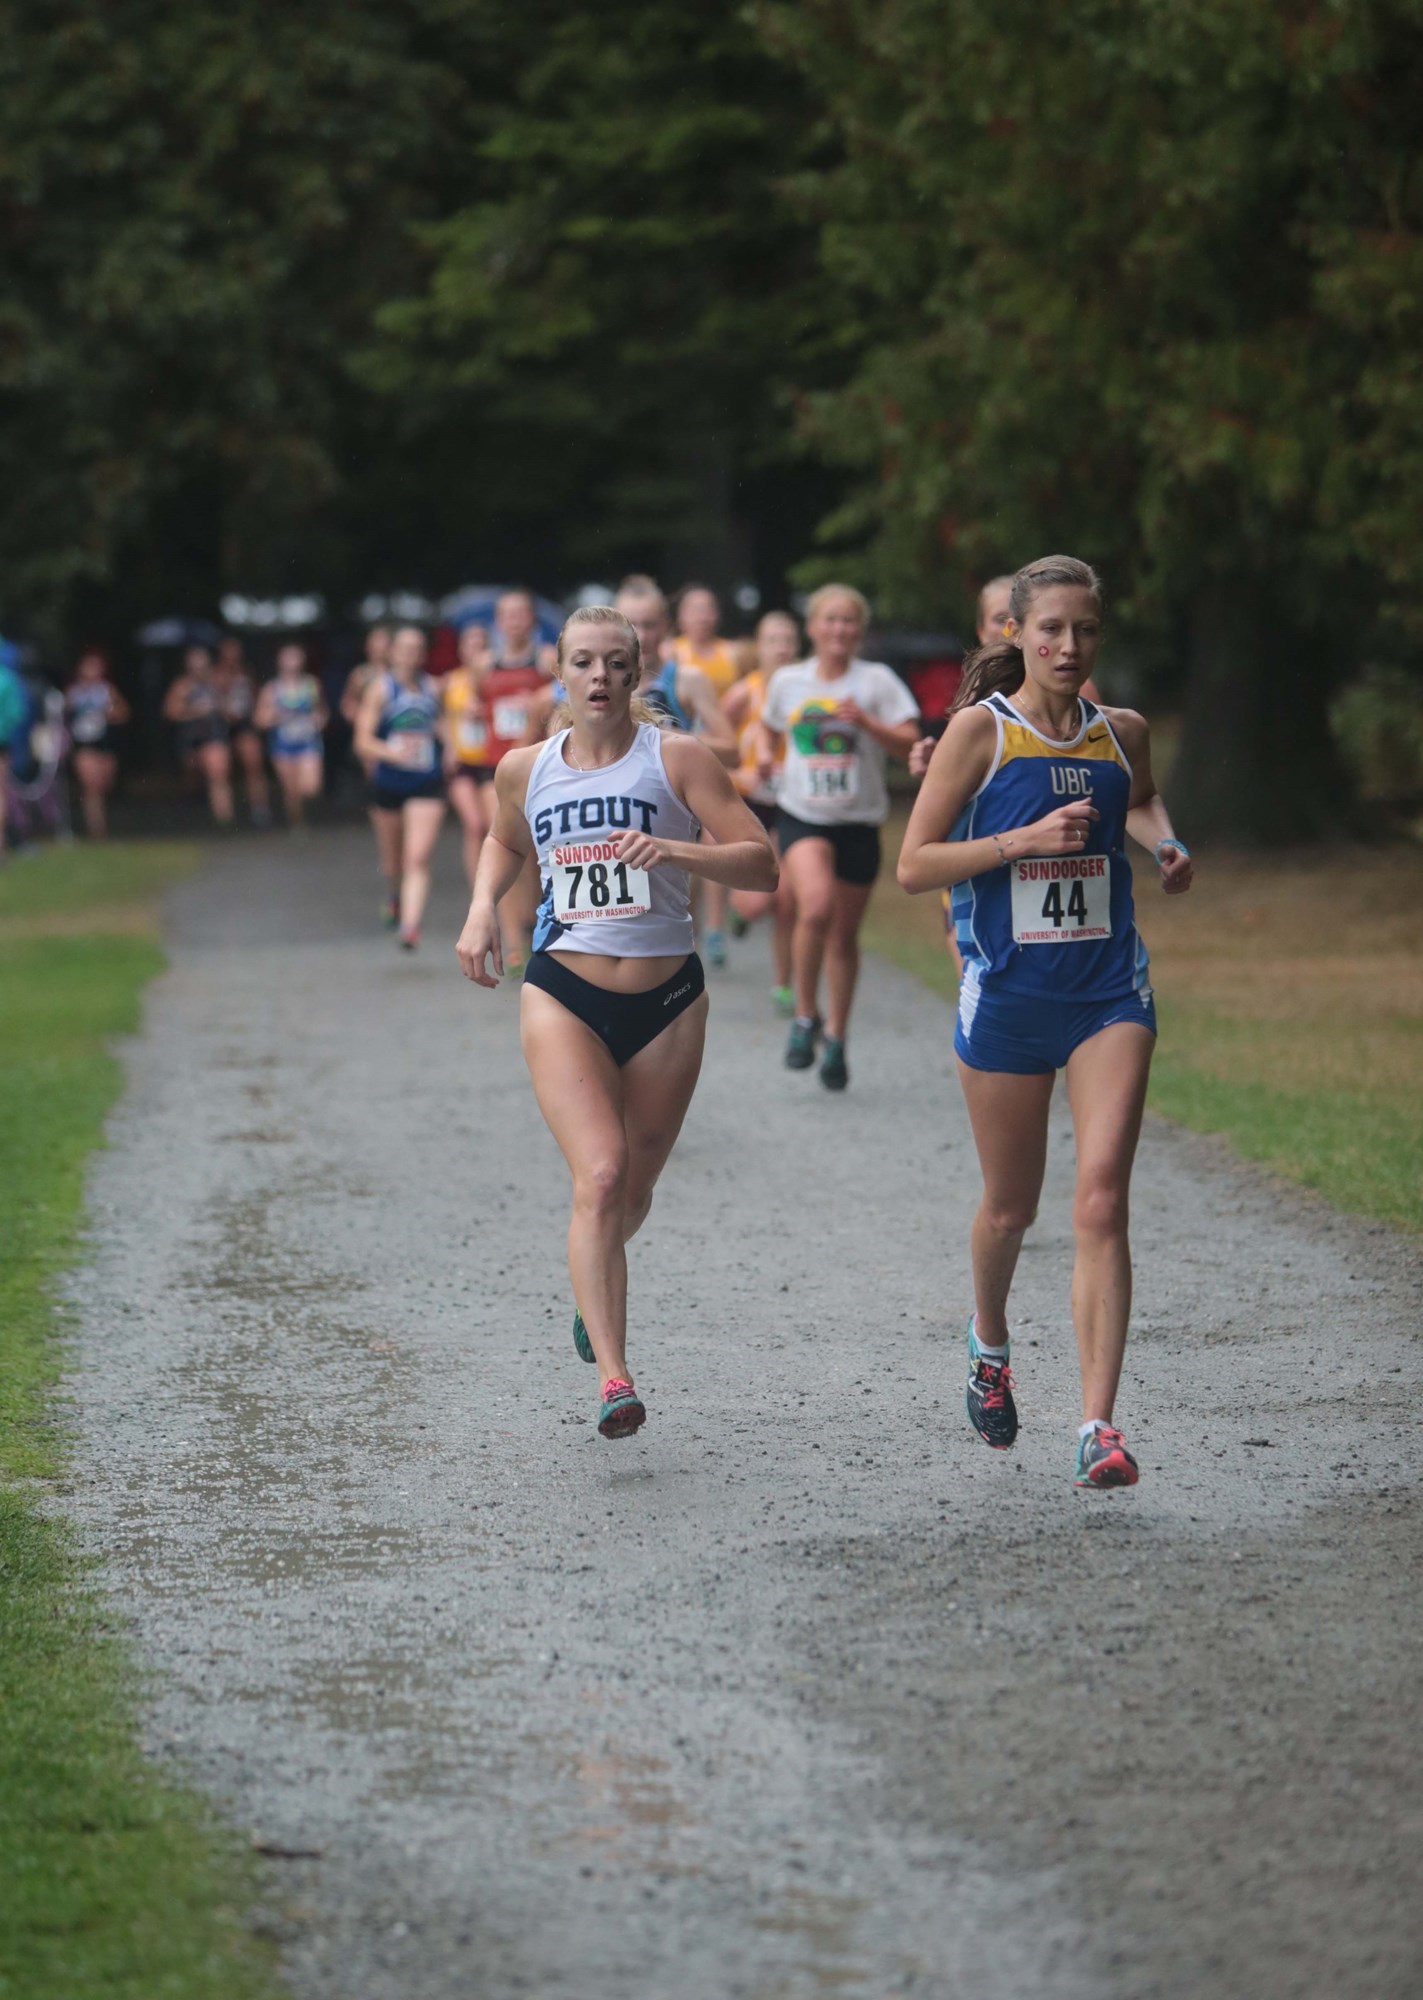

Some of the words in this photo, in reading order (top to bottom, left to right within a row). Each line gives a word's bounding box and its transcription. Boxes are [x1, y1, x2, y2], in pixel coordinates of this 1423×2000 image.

[1050, 766, 1093, 795] UBC
[535, 796, 657, 846] STOUT
[1019, 858, 1105, 881] SUNDODGER
[565, 862, 634, 909] 781
[560, 910, 594, 921] UNIVERSITY
[595, 909, 603, 918] OF
[604, 905, 646, 917] WASHINGTON
[1042, 880, 1088, 928] 44
[1020, 930, 1058, 941] UNIVERSITY
[1061, 930, 1069, 939] OF
[1071, 927, 1107, 938] WASHINGTON
